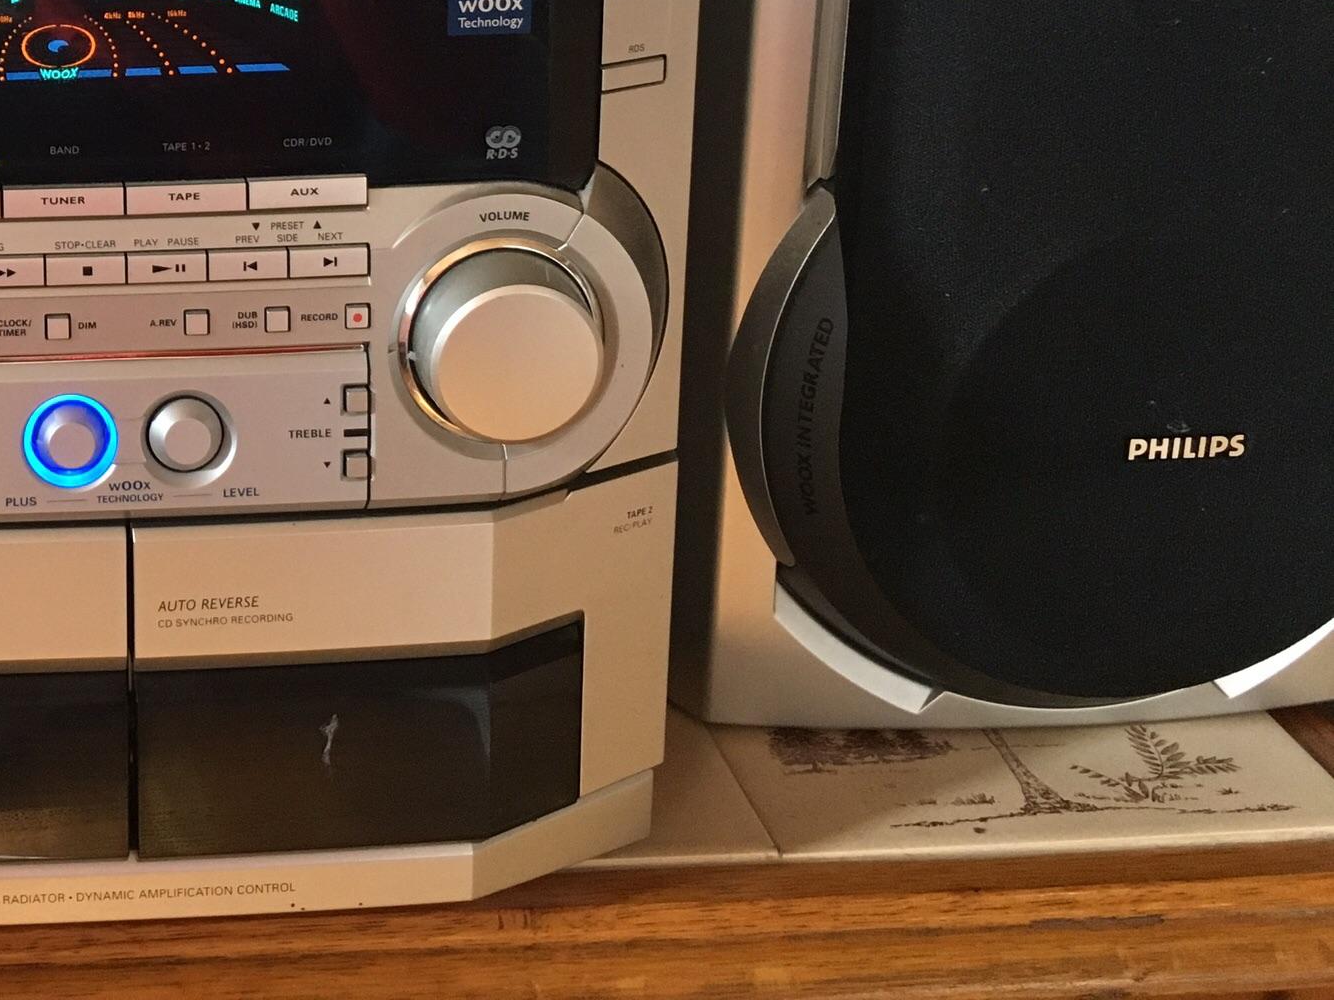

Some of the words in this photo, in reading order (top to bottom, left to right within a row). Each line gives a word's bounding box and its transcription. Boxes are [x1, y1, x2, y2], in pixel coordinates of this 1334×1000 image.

[270, 3, 299, 22] ARCADE
[458, 17, 523, 28] Technology
[49, 145, 80, 156] BAND
[162, 142, 187, 152] TAPE
[168, 192, 201, 202] TAPE
[290, 187, 319, 197] AUX
[40, 196, 86, 206] TUNER
[479, 211, 530, 223] VOLUME
[270, 221, 304, 231] PRESET
[133, 238, 158, 248] PLAY
[167, 236, 199, 247] PAUSE
[235, 235, 260, 245] PREV
[277, 233, 298, 243] SIDE
[317, 231, 344, 242] NEXT
[237, 311, 258, 320] DUB
[300, 313, 339, 322] RECORD
[77, 321, 97, 330] DIM
[149, 318, 177, 328] A.REV
[232, 320, 259, 329] (HSD)
[796, 316, 835, 448] INTEGRATED
[288, 428, 332, 440] TREBLE
[1128, 434, 1245, 461] PHILIPS
[223, 487, 260, 498] LEVEL
[5, 496, 37, 507] PLUS
[97, 493, 164, 504] TECHNOLOGY
[627, 508, 646, 519] TAPE
[158, 599, 196, 612] AUTO
[201, 596, 259, 610] REVERSE
[157, 619, 173, 628] CD
[176, 616, 228, 628] SYNCHRO
[231, 613, 293, 625] RECORDING
[2, 893, 65, 905] RADIATOR
[76, 890, 134, 902] DYNAMIC
[138, 886, 233, 900] AMPLIFICATION
[237, 882, 296, 895] CONTROL
